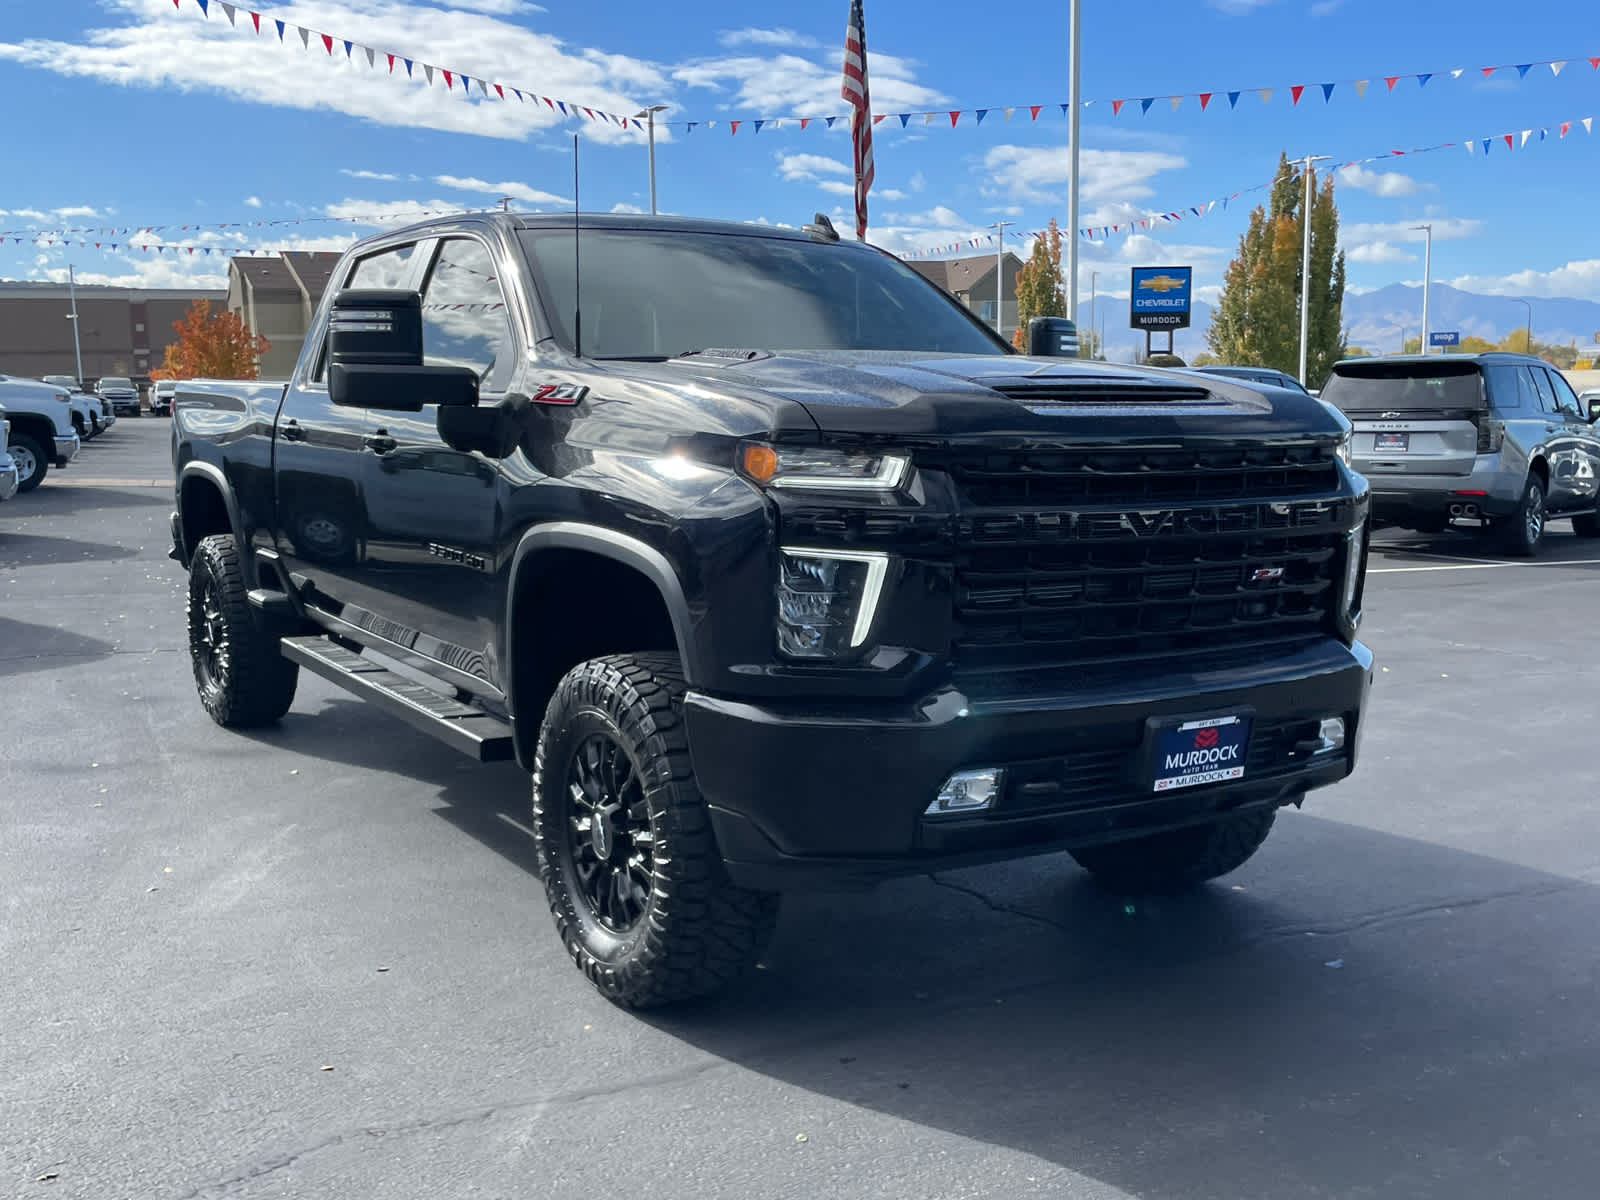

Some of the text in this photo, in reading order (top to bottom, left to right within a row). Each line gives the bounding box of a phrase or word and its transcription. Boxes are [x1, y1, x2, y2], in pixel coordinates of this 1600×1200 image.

[1136, 299, 1186, 307] CHEVROLET
[1140, 316, 1182, 324] MURDOCK
[531, 384, 590, 406] Z71
[1165, 744, 1239, 769] MURDOCK
[1183, 763, 1219, 774] AUTO TEAM
[1175, 771, 1224, 785] MURDOCK
